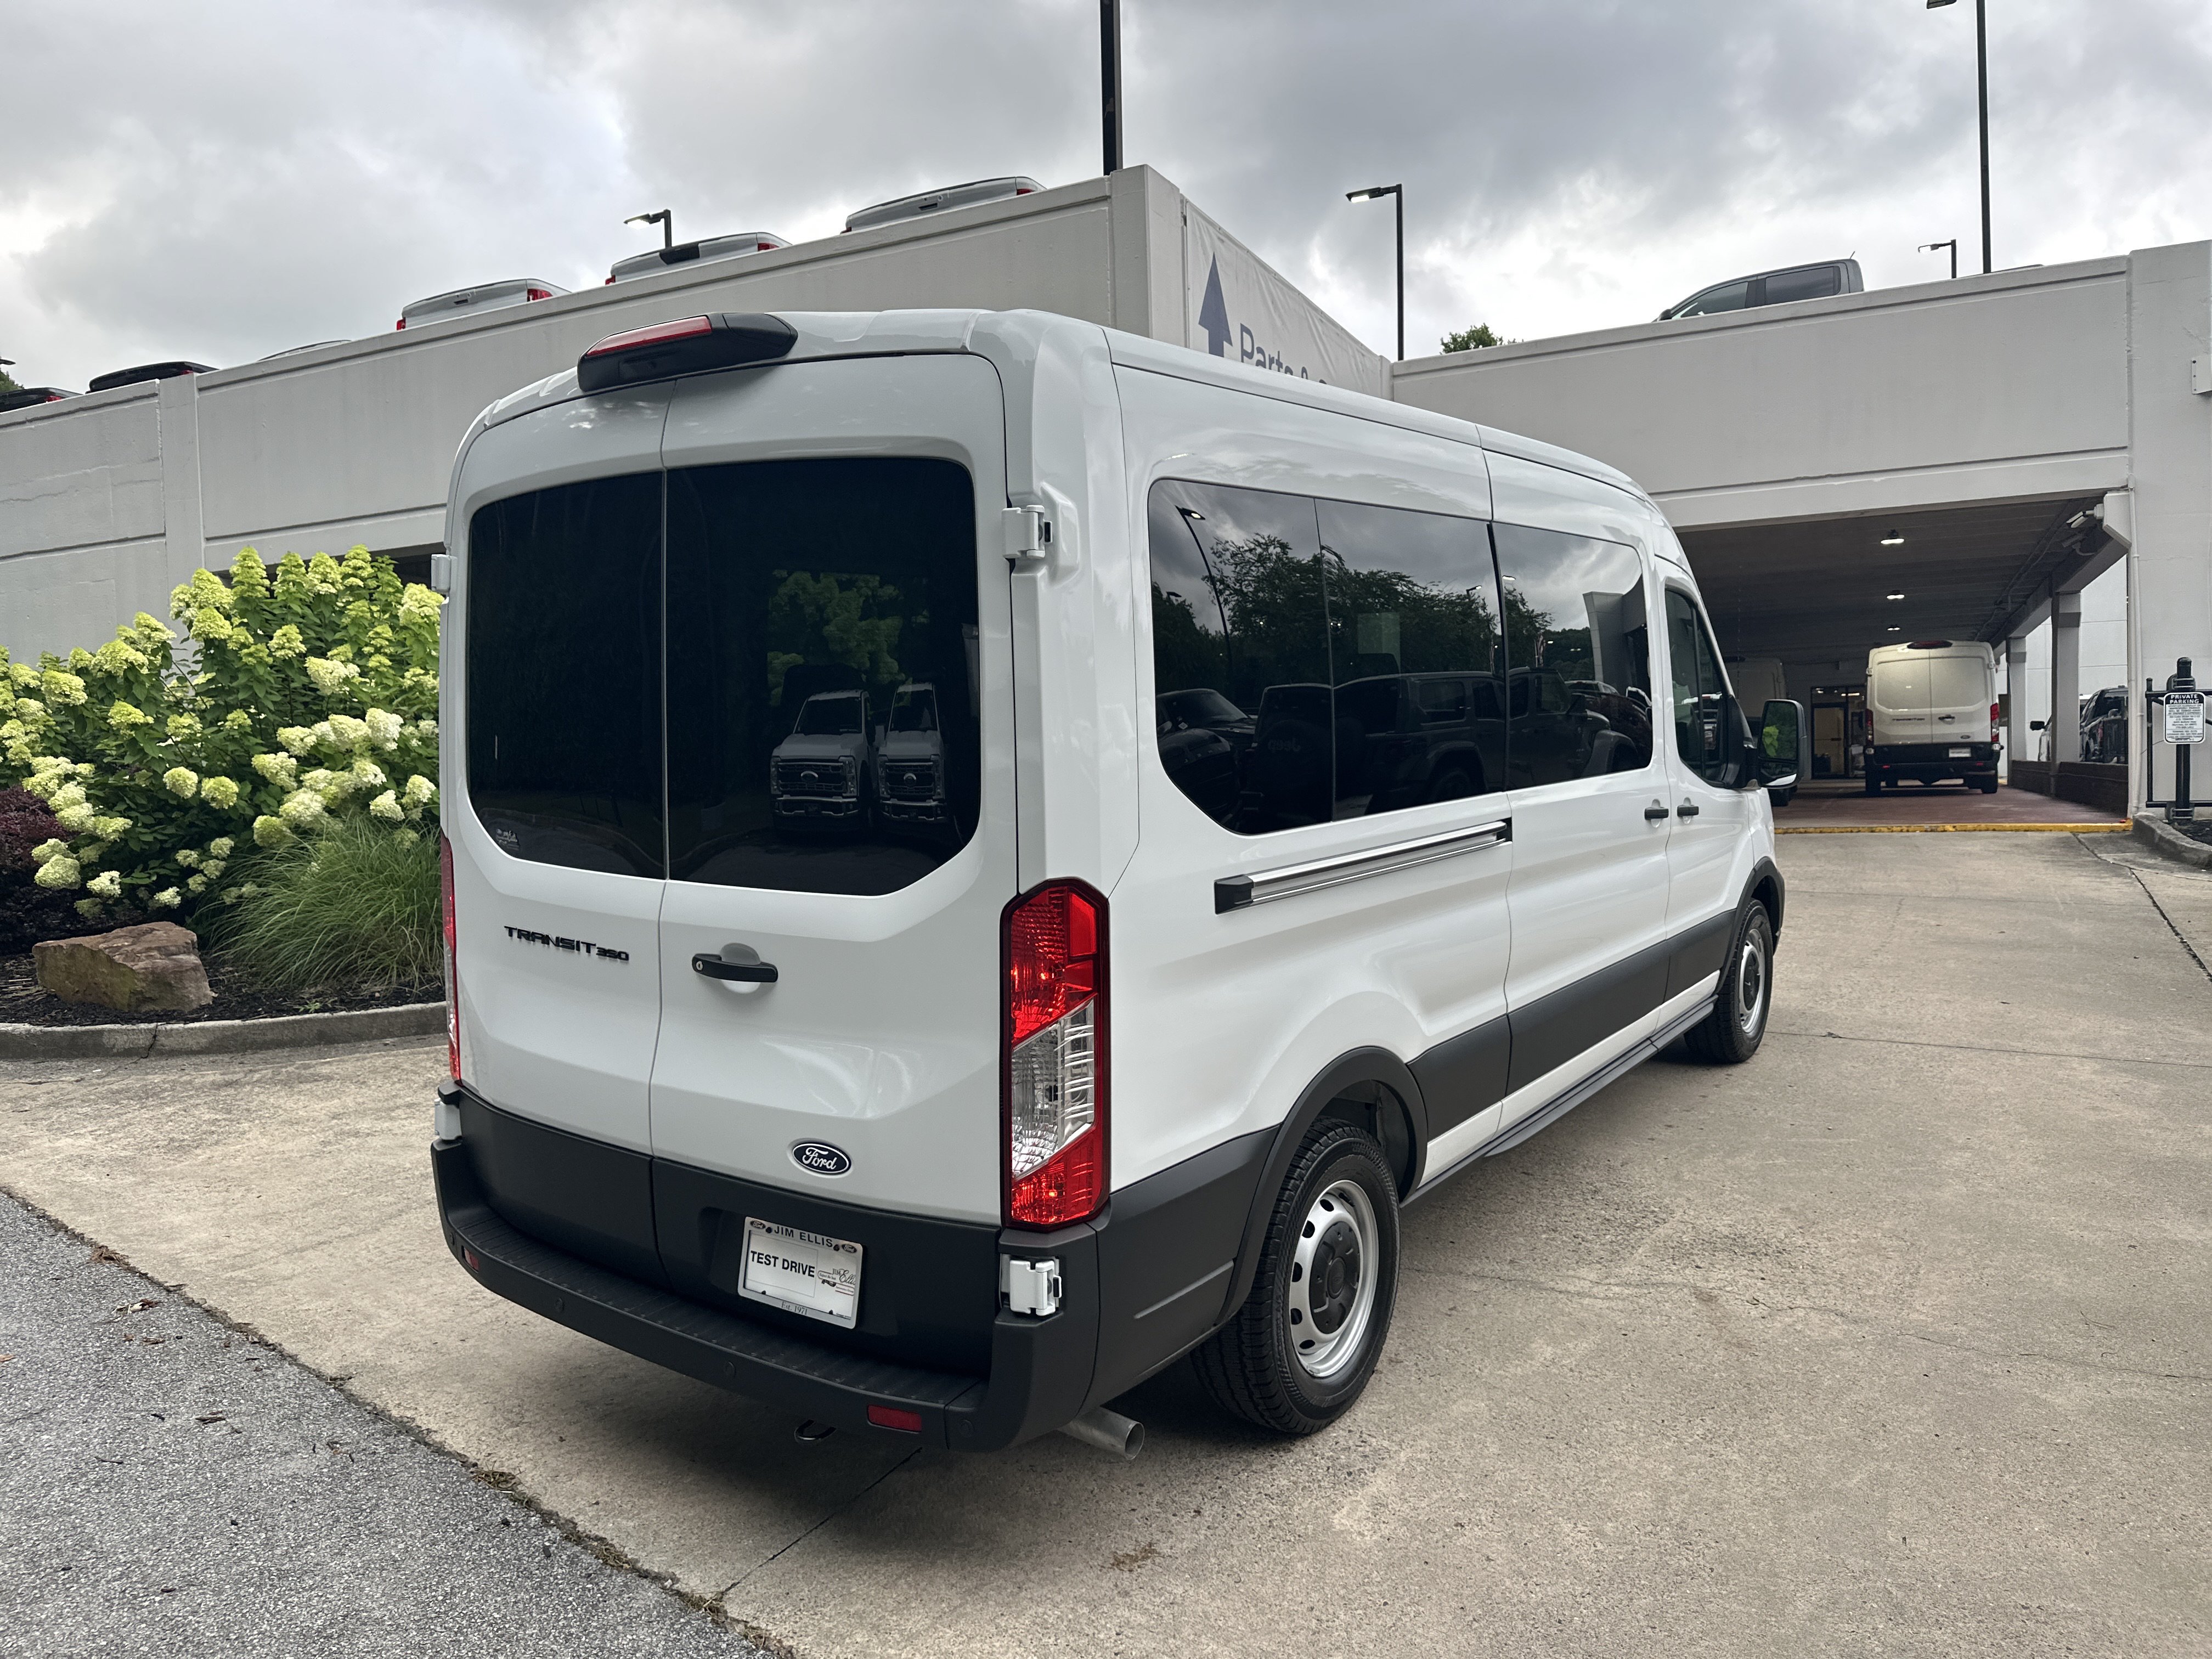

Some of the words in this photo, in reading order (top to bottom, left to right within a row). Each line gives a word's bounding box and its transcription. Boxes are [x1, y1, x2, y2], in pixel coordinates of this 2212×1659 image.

[504, 926, 596, 954] TRANSIT
[802, 1147, 838, 1170] Ford
[774, 1226, 794, 1238] JIM
[799, 1232, 833, 1248] ELLIS
[751, 1250, 779, 1267] TEST
[782, 1259, 815, 1278] DRIVE
[781, 1301, 792, 1311] Est.
[794, 1305, 808, 1315] 1971
